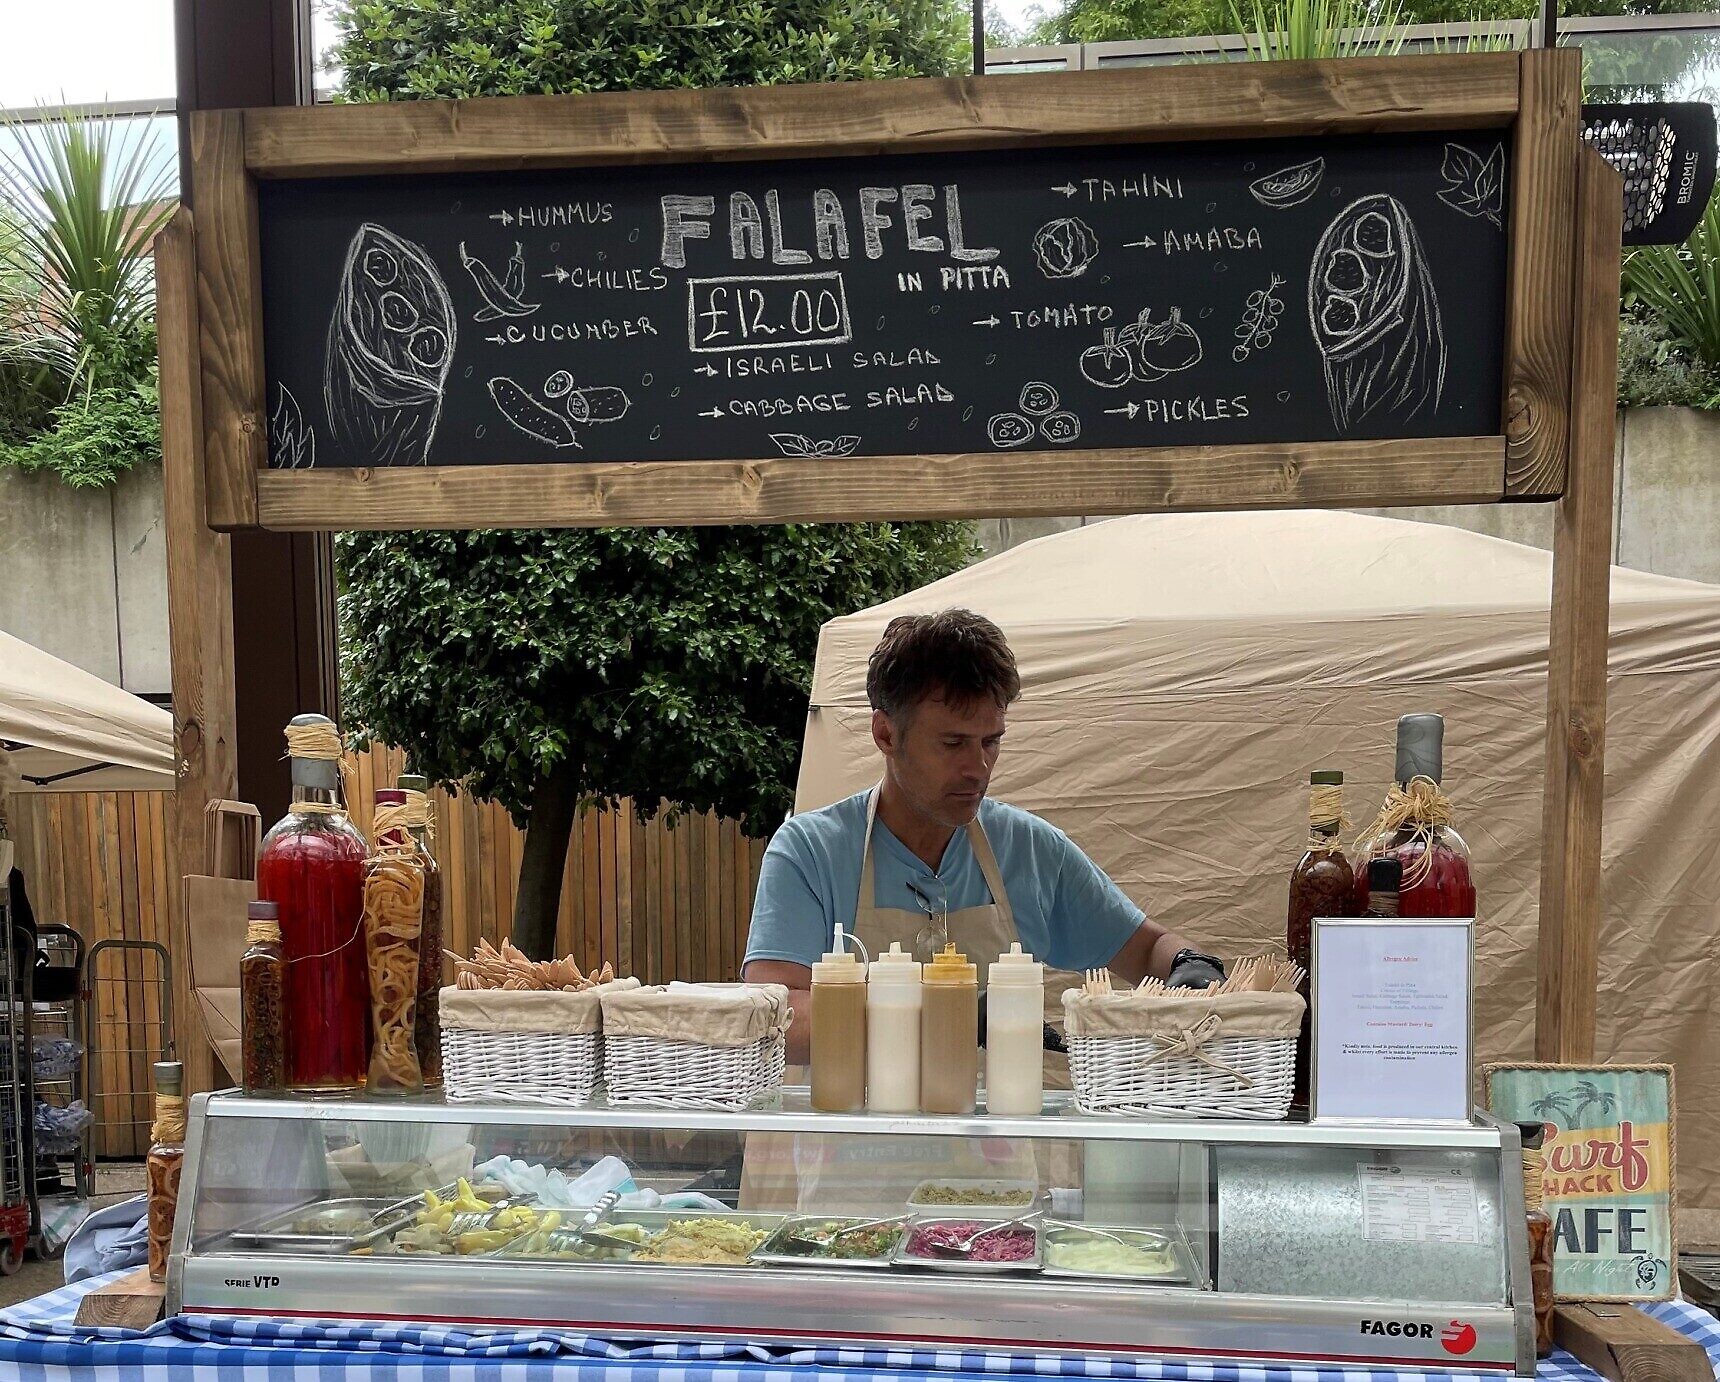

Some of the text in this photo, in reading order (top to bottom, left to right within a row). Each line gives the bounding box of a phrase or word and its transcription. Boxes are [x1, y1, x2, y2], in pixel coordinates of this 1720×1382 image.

[1083, 174, 1183, 201] TAHINI
[1677, 151, 1695, 204] BROMIC
[518, 202, 613, 227] HUMMUS
[660, 184, 1000, 269] FALAFEL
[1164, 227, 1262, 255] AMABA
[571, 267, 668, 291] CHILIES
[898, 265, 1010, 291] IN PITTA
[700, 287, 840, 342] £12.00
[1010, 303, 1113, 329] TOMATO
[506, 316, 657, 343] CUCUMBER
[727, 348, 941, 378] ISRAELI SALAD
[729, 382, 954, 418] CABBAGE SALAD
[1145, 395, 1249, 423] PICKLES
[1543, 1174, 1614, 1196] HACK
[1554, 1208, 1647, 1254] AFE
[1360, 1320, 1434, 1339] FAGOR
